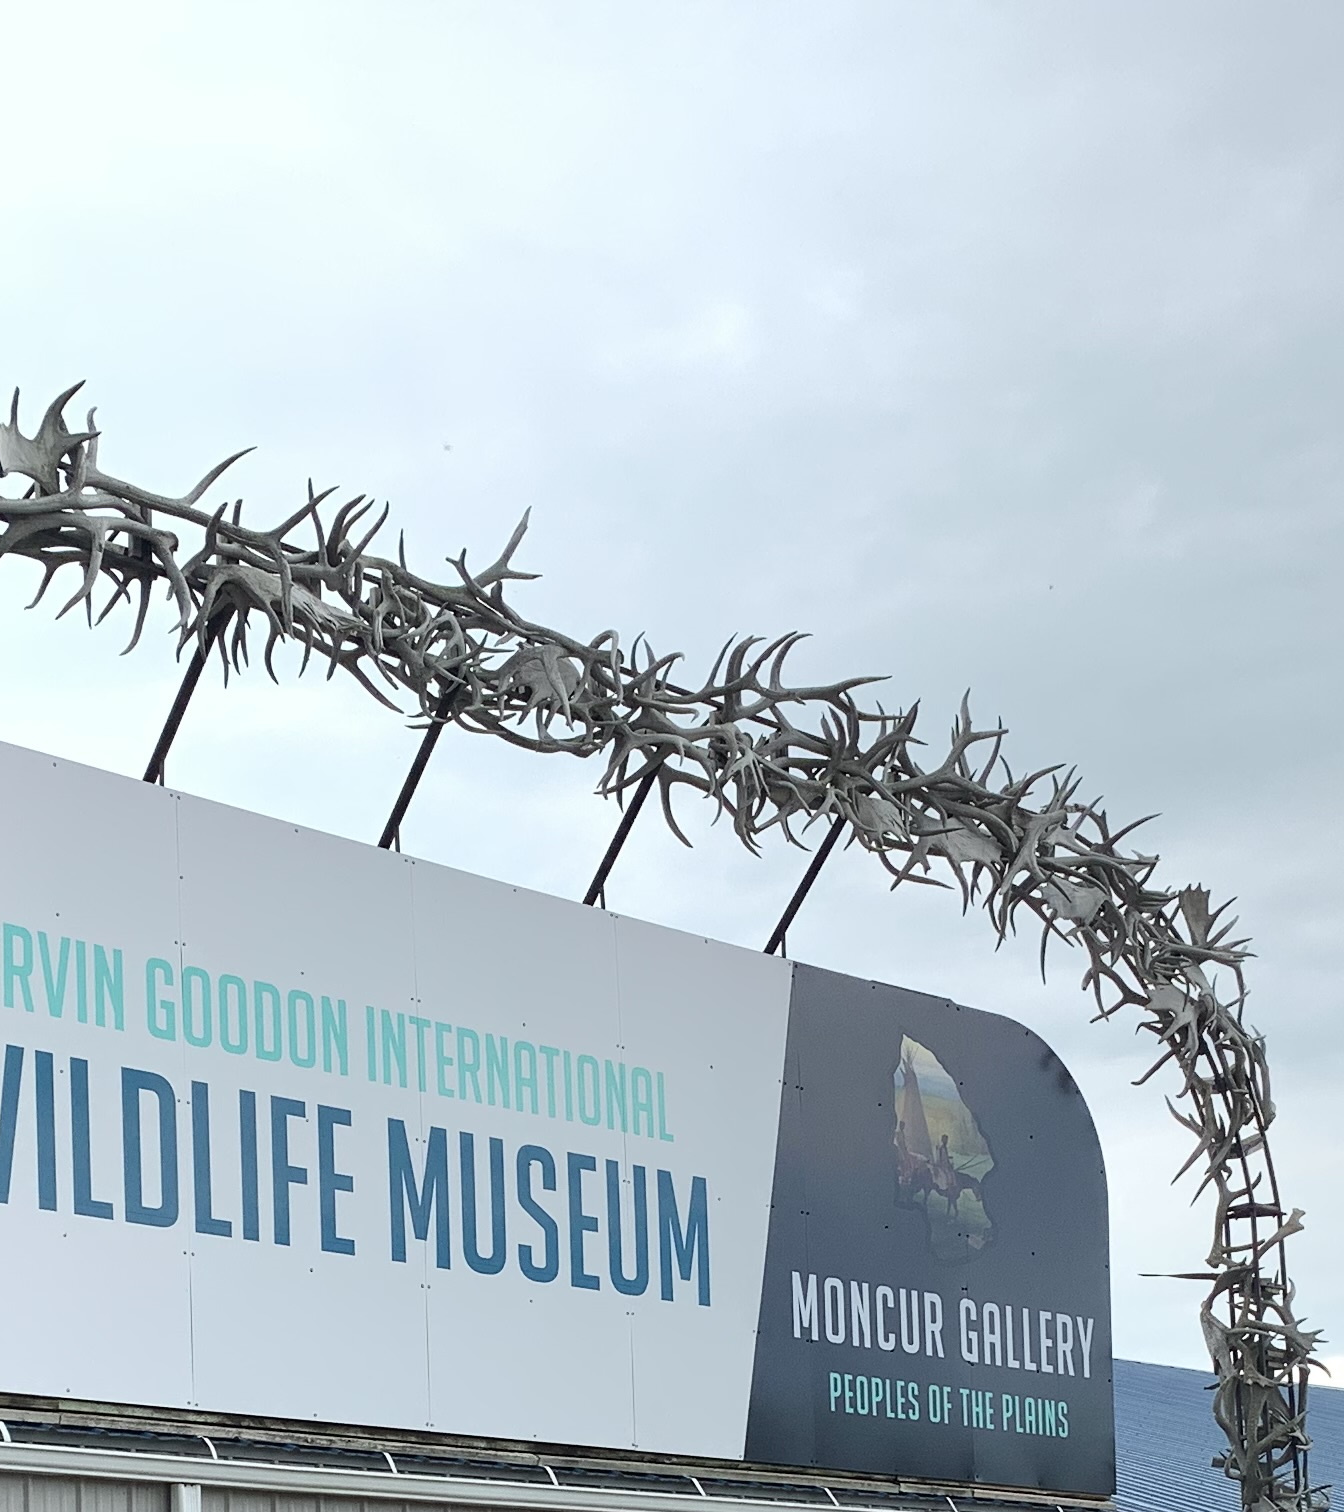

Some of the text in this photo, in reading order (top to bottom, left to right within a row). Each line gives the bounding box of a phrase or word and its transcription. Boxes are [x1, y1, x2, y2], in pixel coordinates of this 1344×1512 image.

[145, 957, 349, 1077] GOODON
[364, 1005, 675, 1143] INTERNATIONAL
[388, 1118, 712, 1308] MUSEUM
[791, 1271, 1094, 1379] MONCUR GALLERY
[829, 1371, 1069, 1438] PEOPLES OF THE PLAINS
